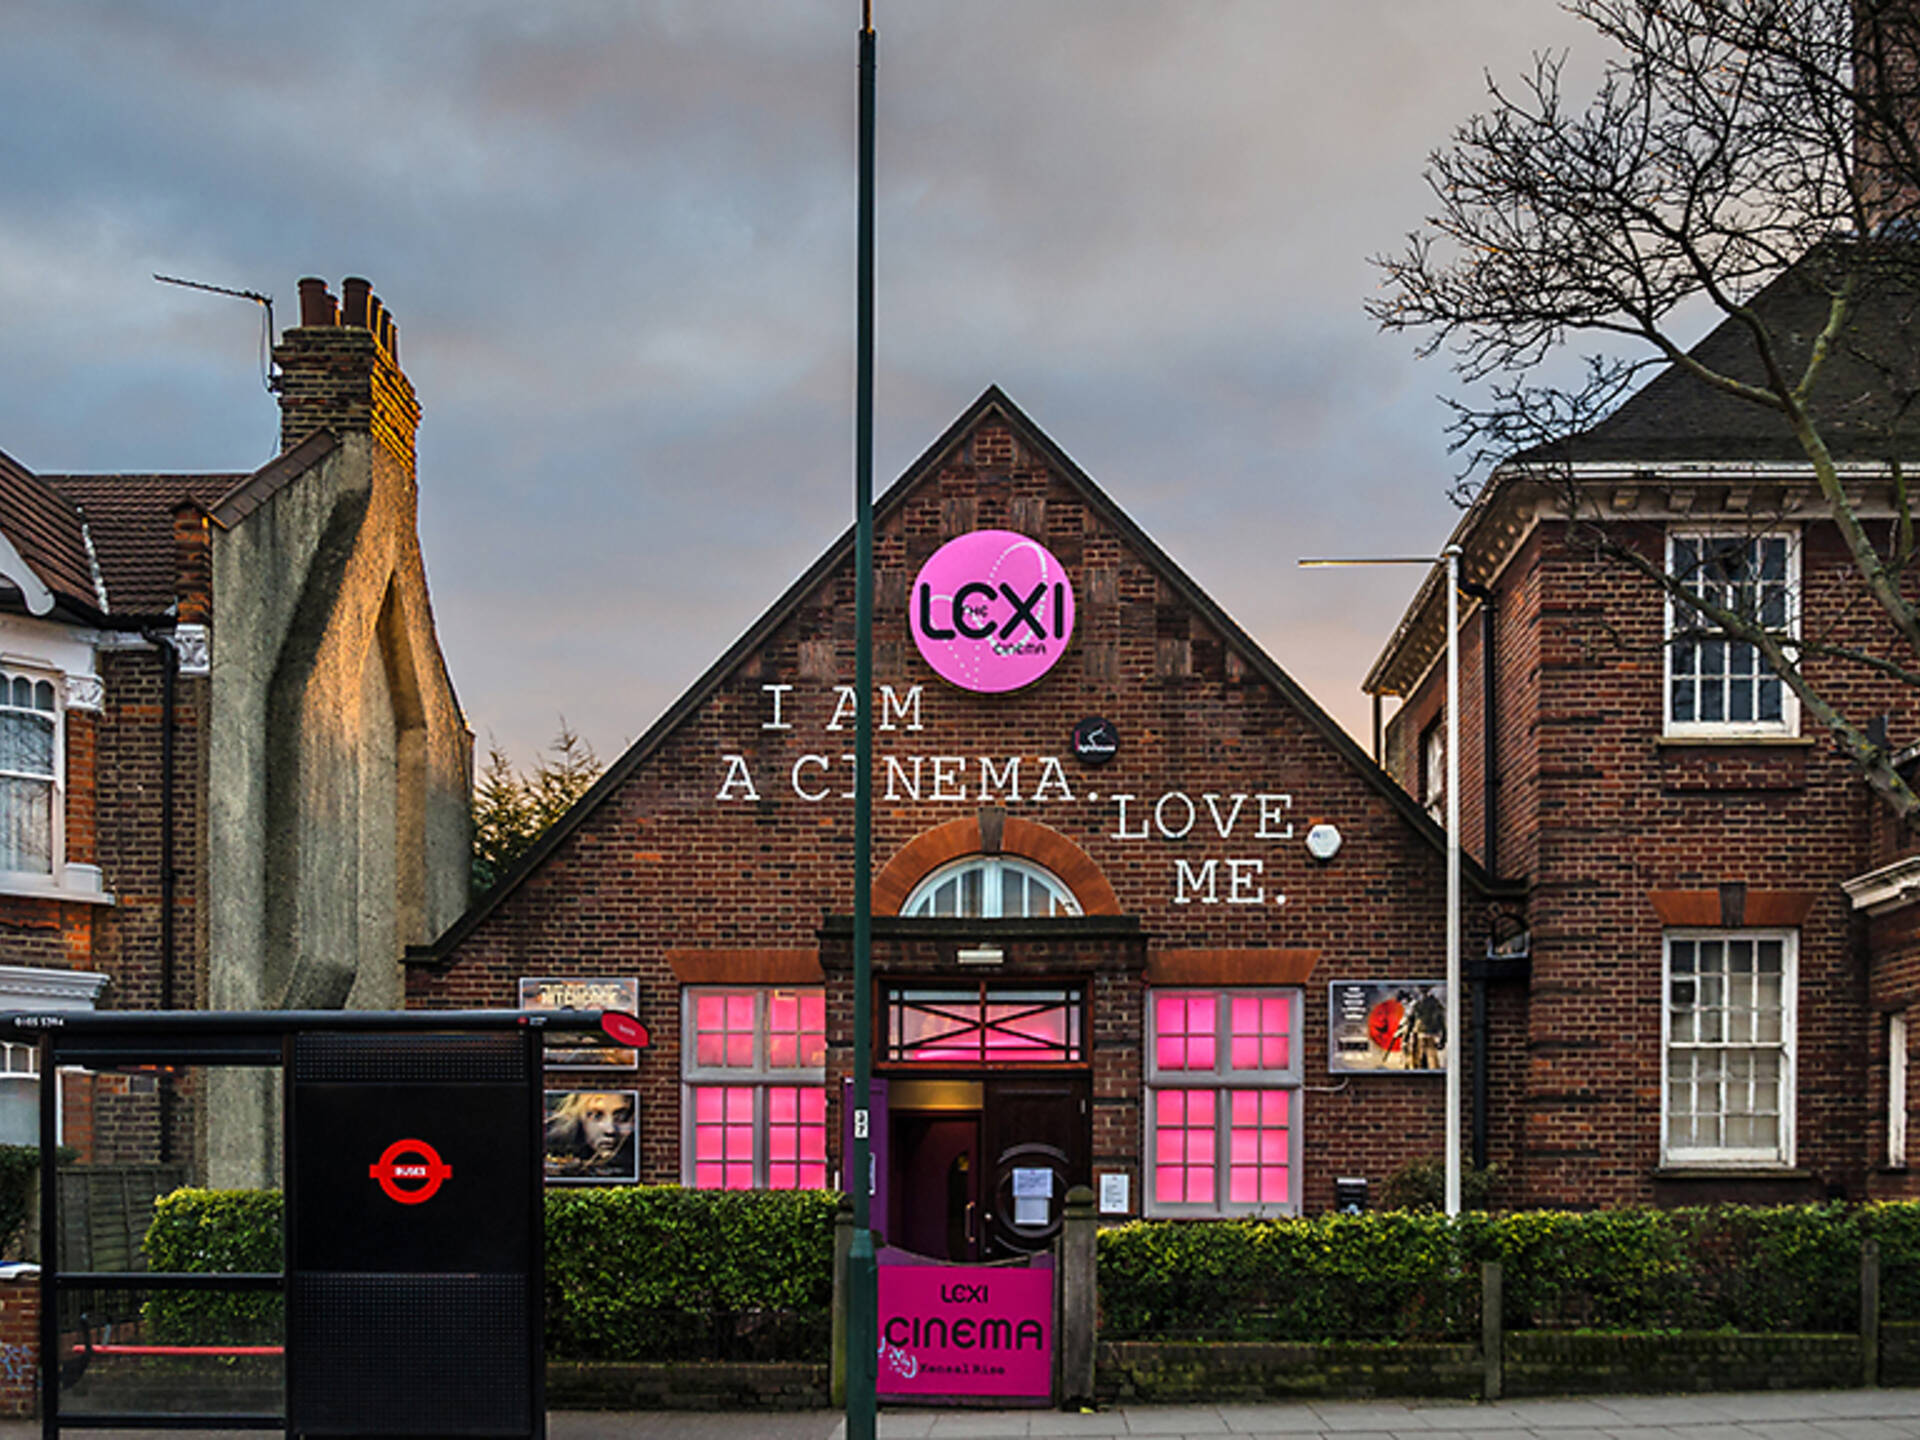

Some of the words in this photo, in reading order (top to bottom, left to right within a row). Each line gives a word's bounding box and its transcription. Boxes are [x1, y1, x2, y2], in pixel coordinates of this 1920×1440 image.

[762, 684, 792, 729] I
[826, 685, 923, 731] AM
[715, 755, 761, 800] A
[1110, 791, 1293, 839] LOVE
[1174, 859, 1287, 904] ME.
[884, 1316, 1043, 1350] CINEMA
